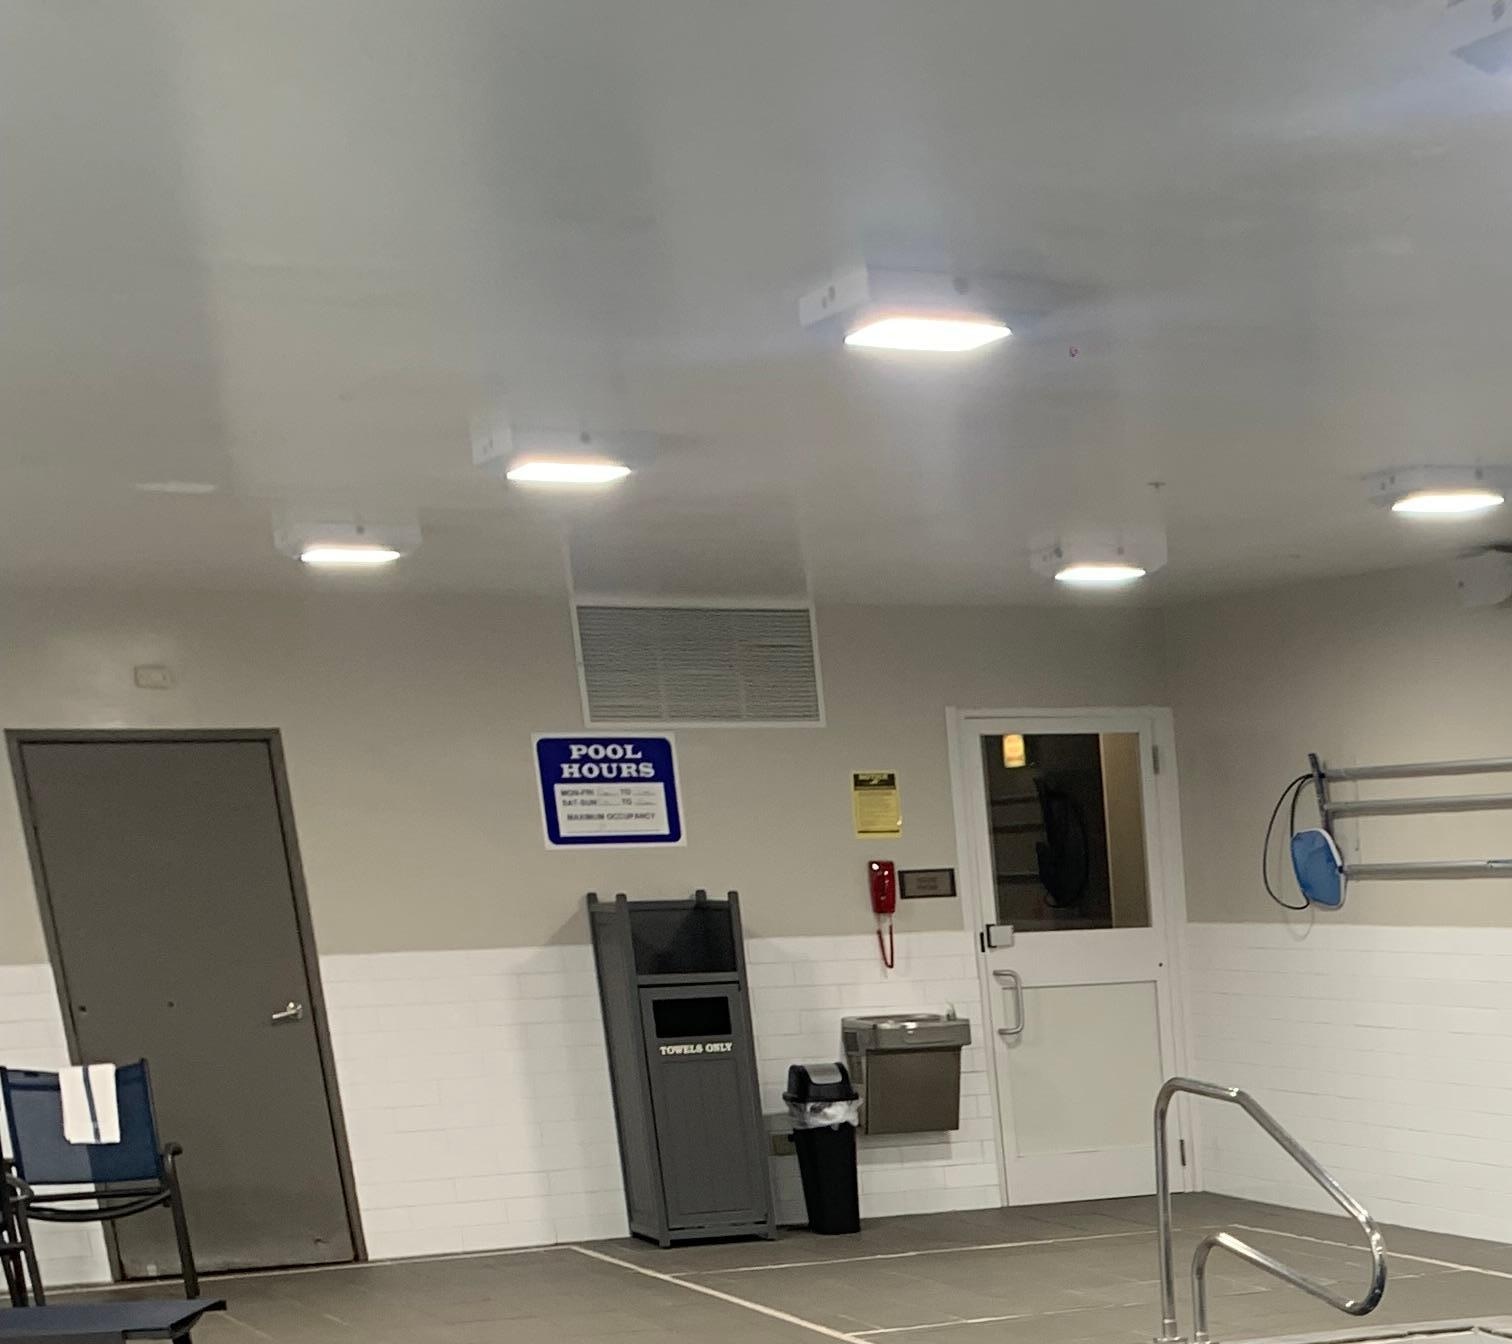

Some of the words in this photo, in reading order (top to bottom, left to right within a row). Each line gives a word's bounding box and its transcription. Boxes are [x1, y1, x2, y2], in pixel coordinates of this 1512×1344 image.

[569, 744, 642, 759] POOL
[560, 762, 655, 778] HOURS
[660, 1044, 703, 1055] TOWELS
[705, 1042, 733, 1053] ONLY
